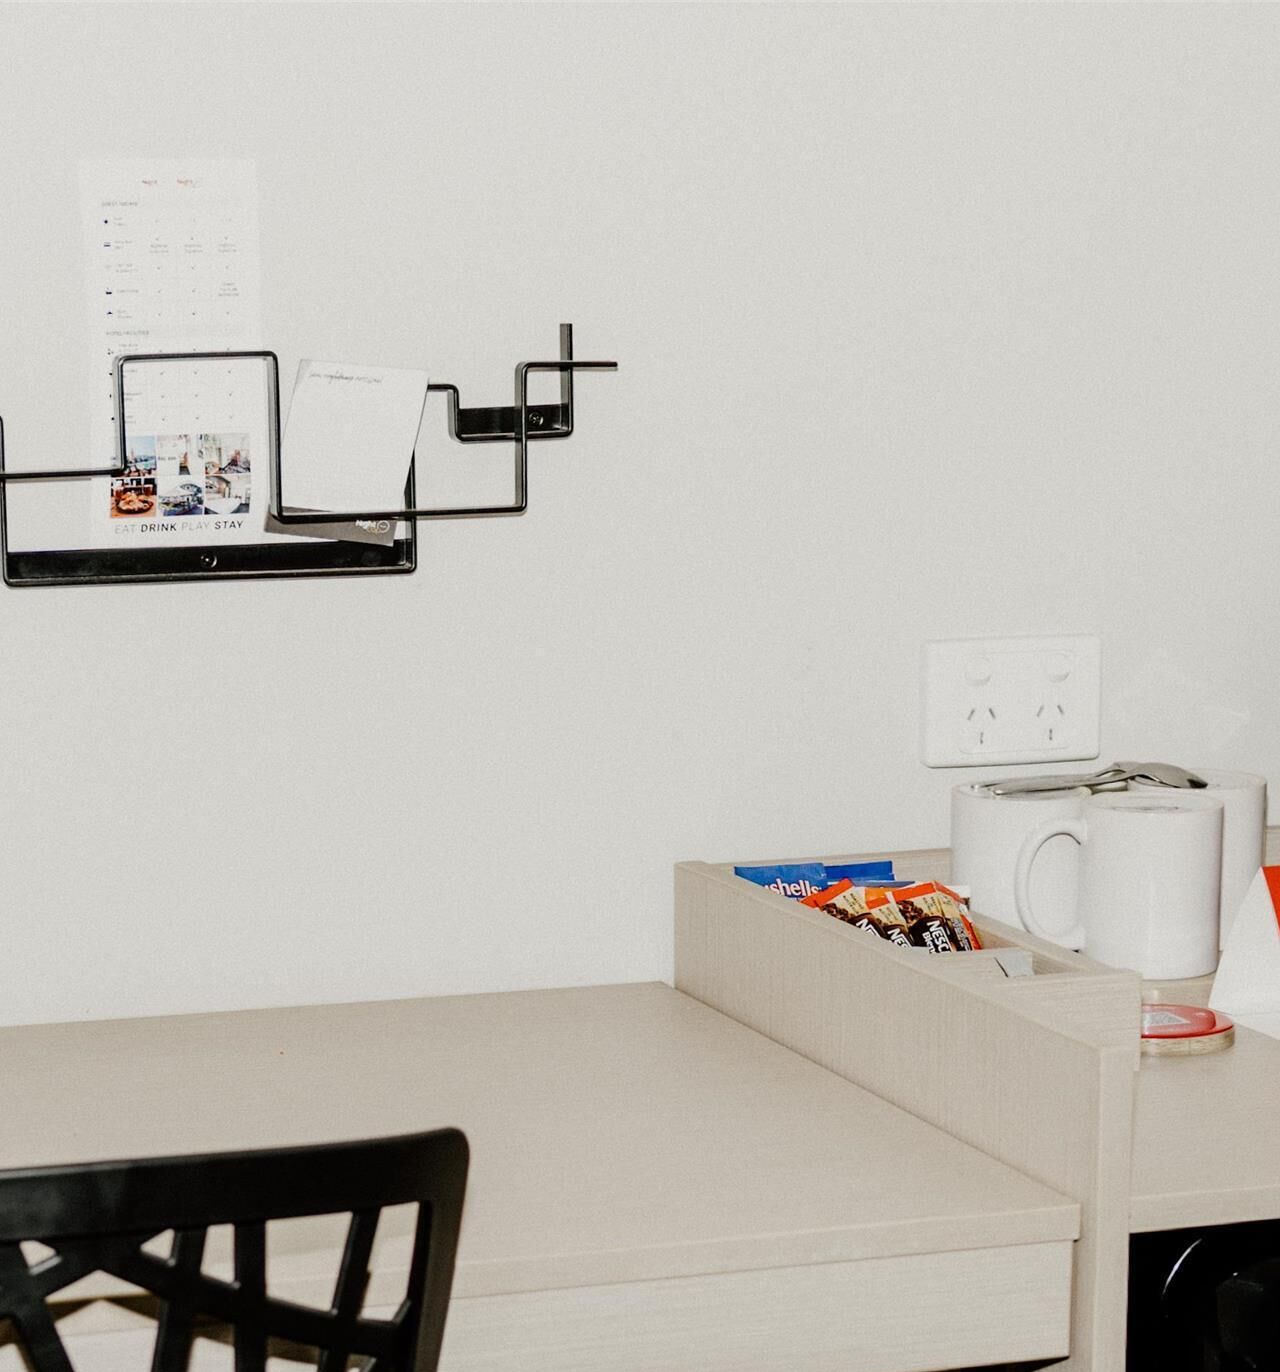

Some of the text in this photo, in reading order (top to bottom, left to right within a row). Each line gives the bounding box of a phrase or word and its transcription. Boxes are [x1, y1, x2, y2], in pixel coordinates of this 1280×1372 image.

[115, 520, 244, 535] EAT DRINK PLAY STAY
[764, 877, 819, 897] shells
